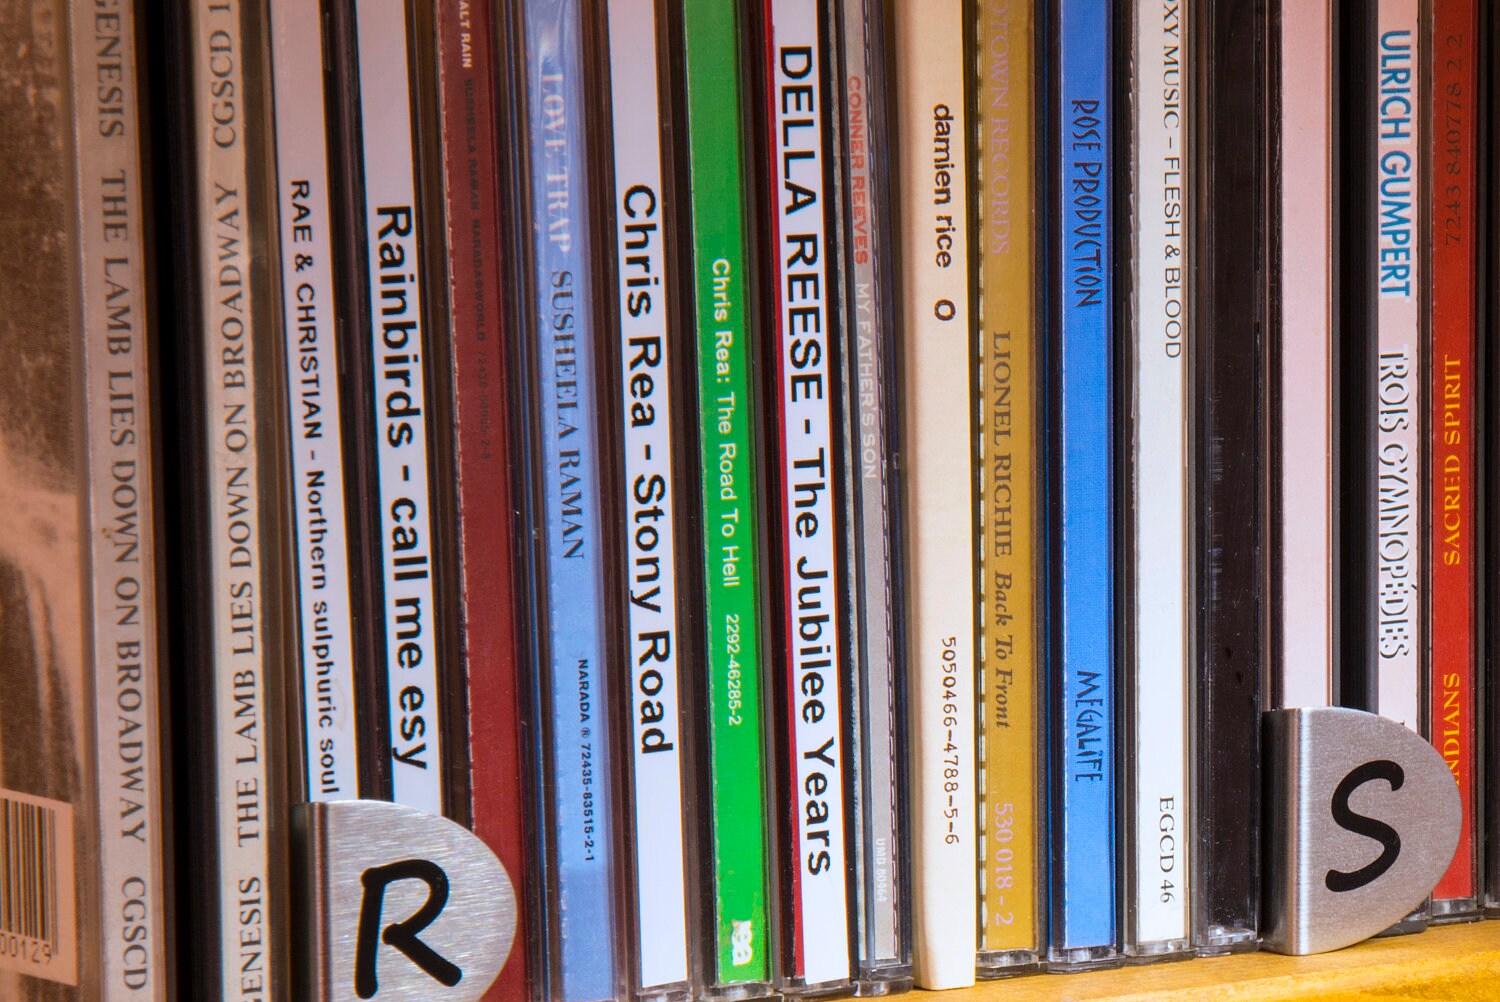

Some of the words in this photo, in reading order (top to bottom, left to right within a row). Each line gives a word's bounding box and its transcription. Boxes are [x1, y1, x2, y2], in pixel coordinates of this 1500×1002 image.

[541, 73, 568, 159] LOVE
[847, 75, 866, 168] CONNER
[1071, 99, 1101, 152] ROSE
[1162, 45, 1180, 130] MUSIC
[1380, 29, 1412, 140] ULRICH
[780, 46, 817, 216] DELLA
[931, 102, 955, 206] damien
[101, 170, 129, 242] THE
[290, 180, 312, 243] RAE
[546, 167, 573, 253] TRAP
[852, 171, 869, 266] REEVES
[935, 214, 957, 269] rice
[1163, 155, 1181, 239] FLESH
[1379, 149, 1412, 298] GUMPERT
[104, 257, 132, 356] LAMB
[376, 205, 422, 449] Rainbirds
[711, 257, 732, 322] Chris
[785, 233, 824, 403] REESE
[855, 282, 870, 315] MY
[1165, 267, 1182, 360] BLOOD
[295, 282, 323, 439] CHRISTIAN
[551, 270, 580, 439] SUSHEELA
[714, 330, 734, 383] Rea:
[857, 321, 877, 427] FATHER'S
[992, 330, 1012, 446] LIONEL
[1379, 352, 1410, 434] TROIS
[107, 370, 135, 447] LIES
[717, 391, 735, 435] The
[719, 443, 738, 502] Road
[793, 447, 827, 539] The
[863, 436, 877, 479] SON
[110, 460, 139, 564] DOWN
[306, 470, 328, 590] Northern
[390, 497, 429, 582] call
[558, 449, 585, 560] RAMAN
[721, 508, 740, 538] To
[993, 452, 1013, 558] RICHIE
[115, 577, 141, 627] ON
[722, 544, 741, 588] Hell
[994, 570, 1014, 628] Back
[311, 600, 338, 729] sulphuric
[394, 596, 424, 670] me
[724, 613, 743, 726] 2292-46285-2
[796, 555, 832, 725] Jubilee
[995, 633, 1014, 661] To
[389, 684, 428, 770] esy
[577, 658, 591, 722] NARADA
[995, 665, 1014, 729] Front
[115, 640, 147, 843] BROADWAY
[319, 739, 340, 795] soul
[939, 636, 960, 846] 5050466-4788-5-6
[580, 743, 596, 862] 72435-83515-2-1
[803, 737, 836, 876] Years
[1158, 795, 1176, 874] EGCD
[1325, 759, 1405, 893] S
[355, 859, 462, 999] R
